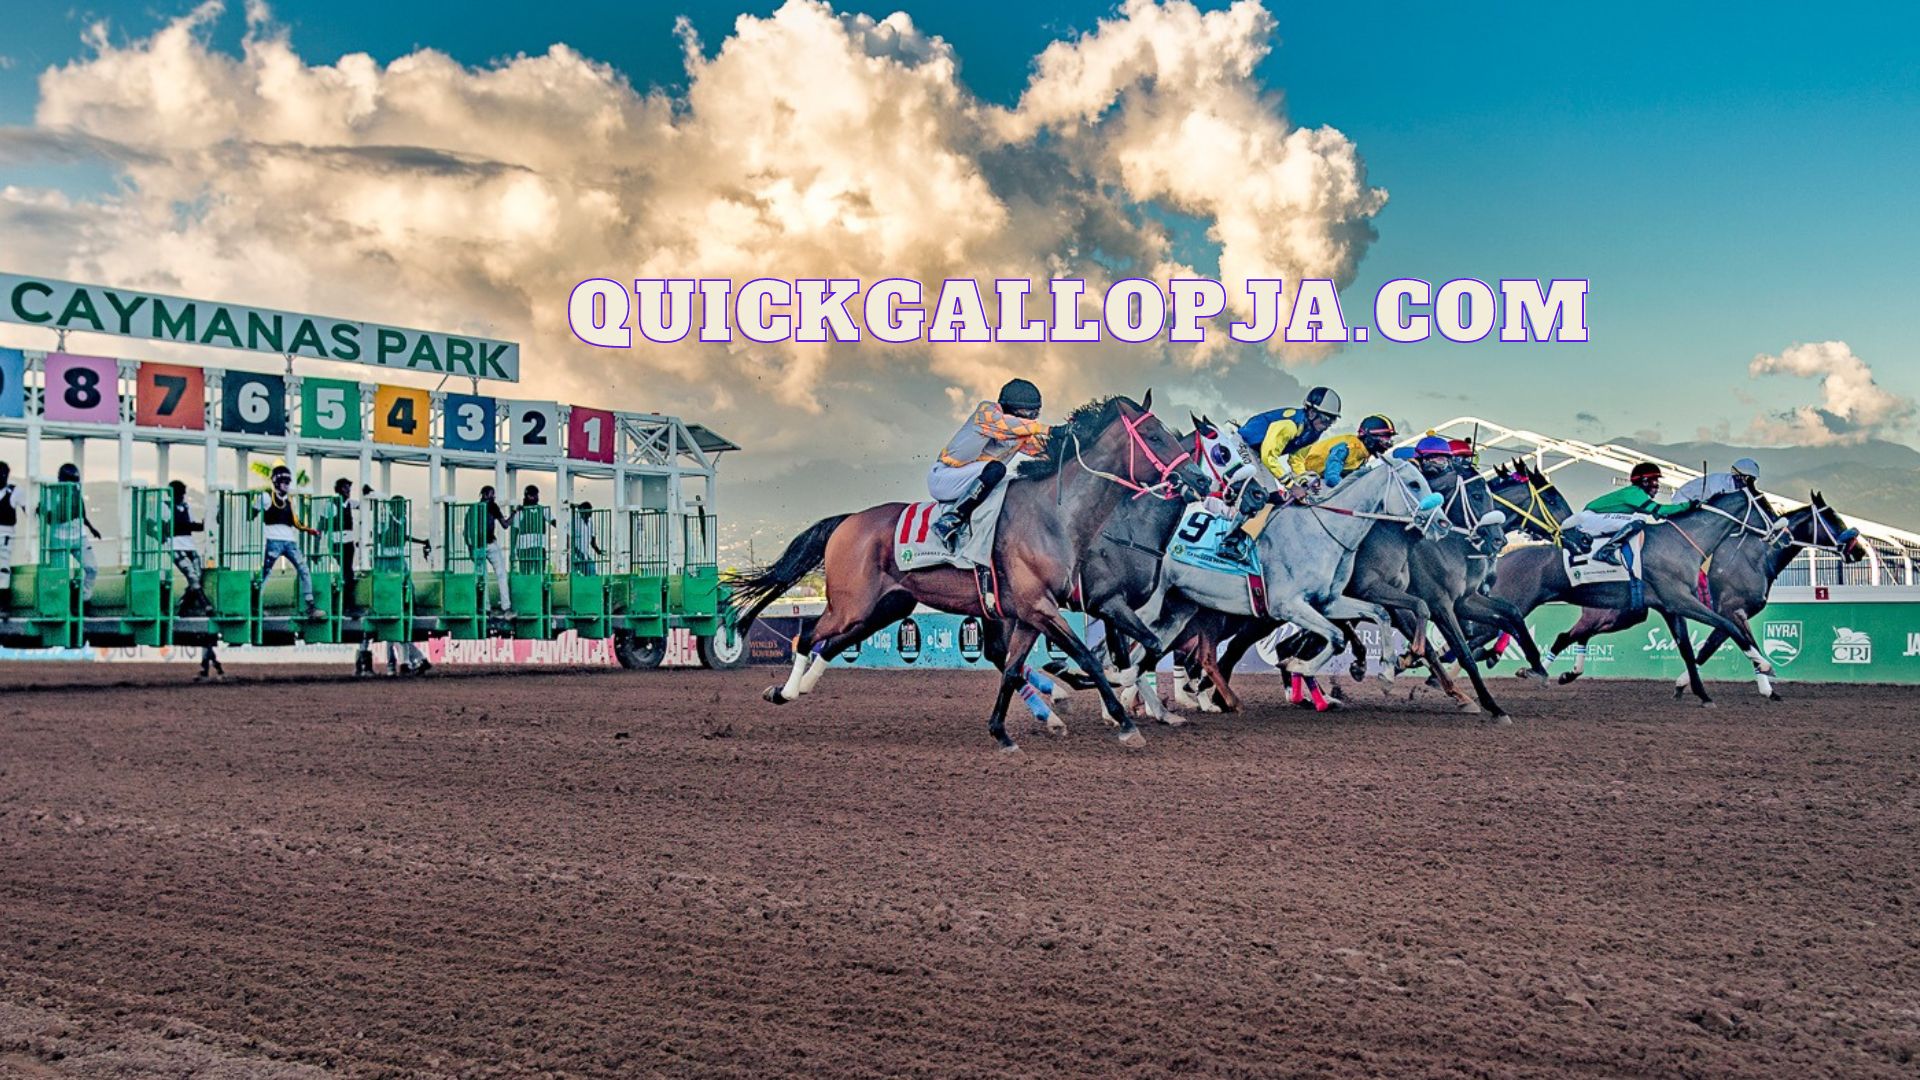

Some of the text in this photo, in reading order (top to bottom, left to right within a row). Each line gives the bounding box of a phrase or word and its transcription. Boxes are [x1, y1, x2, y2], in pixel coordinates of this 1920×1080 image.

[11, 281, 510, 379] CAYMANAS PARK
[63, 367, 101, 409] 8
[154, 374, 187, 416] 7
[237, 381, 270, 424] 6
[316, 388, 346, 430] 5
[387, 397, 417, 435] 4
[457, 403, 485, 441] 3
[522, 410, 547, 445] 2
[583, 416, 601, 453] 1
[900, 502, 938, 544] 11
[1178, 511, 1215, 543] 9
[1767, 624, 1798, 637] NYRA
[1833, 646, 1869, 661] CPJ
